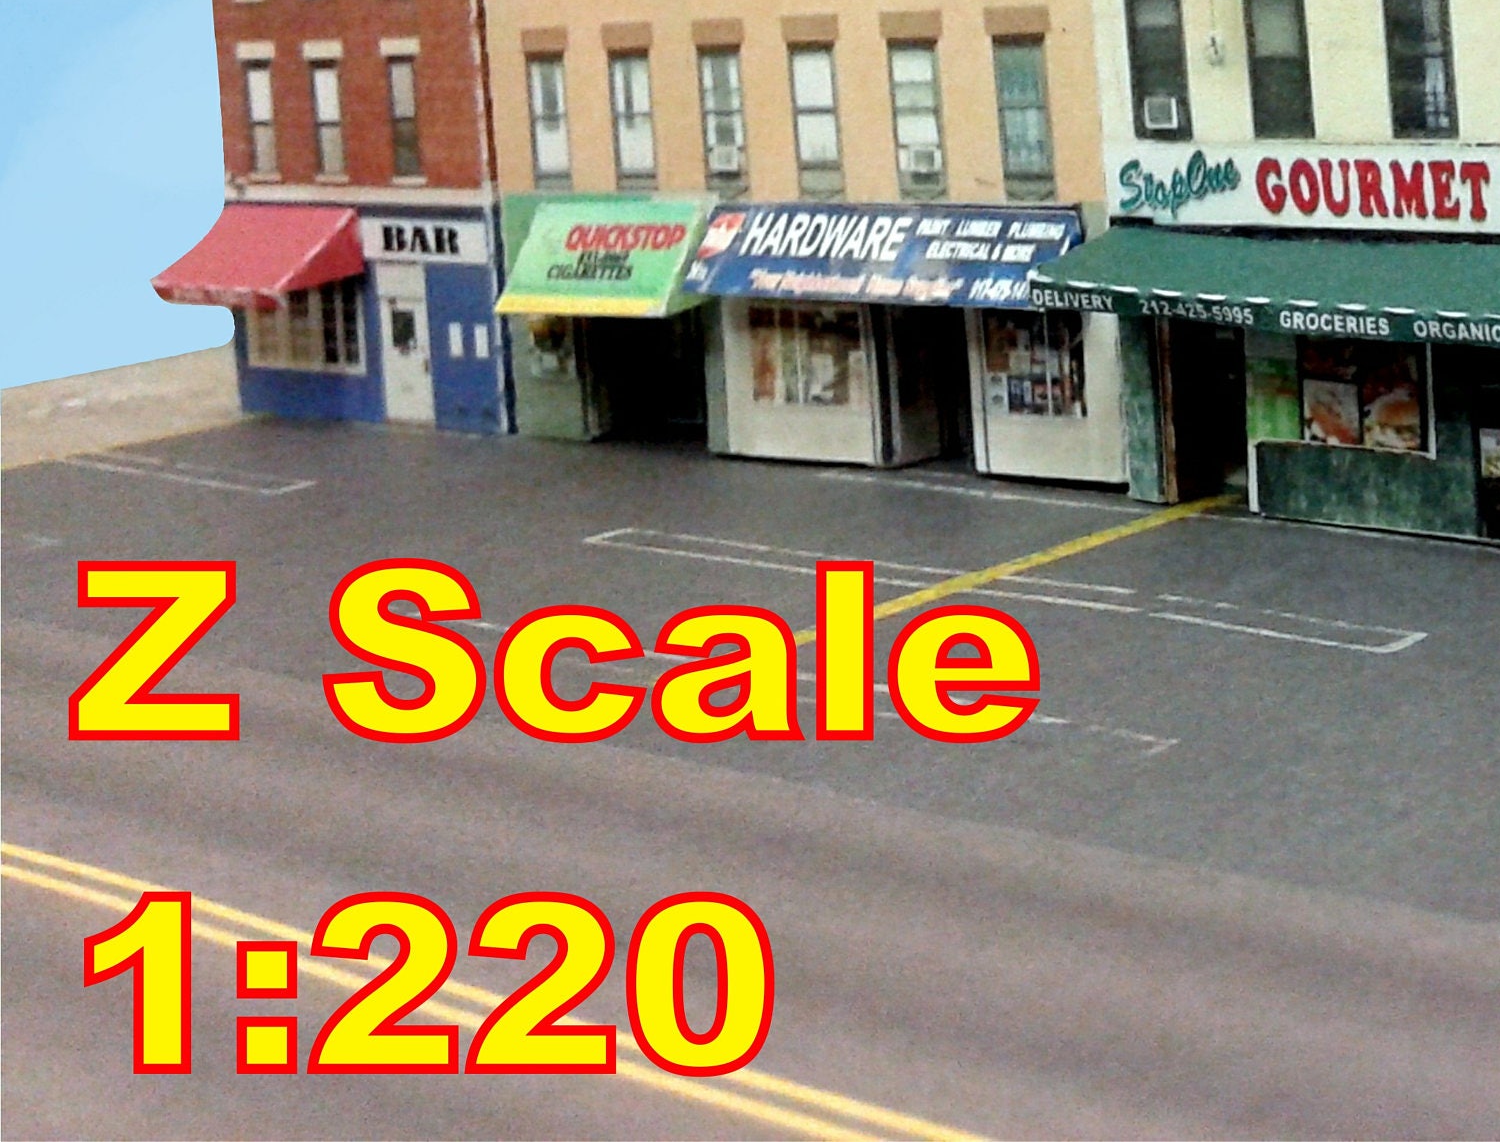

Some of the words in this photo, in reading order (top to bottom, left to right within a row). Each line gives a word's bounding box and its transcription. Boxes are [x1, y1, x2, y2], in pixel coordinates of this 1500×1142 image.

[1255, 157, 1490, 222] GOURMET
[382, 225, 460, 254] BAR
[564, 223, 687, 252] QUICKSTOP
[739, 212, 913, 261] HARDWARE
[1032, 288, 1114, 310] DELIVERY
[1139, 299, 1254, 326] 212-425-5995
[1279, 310, 1390, 336] GROCERIES
